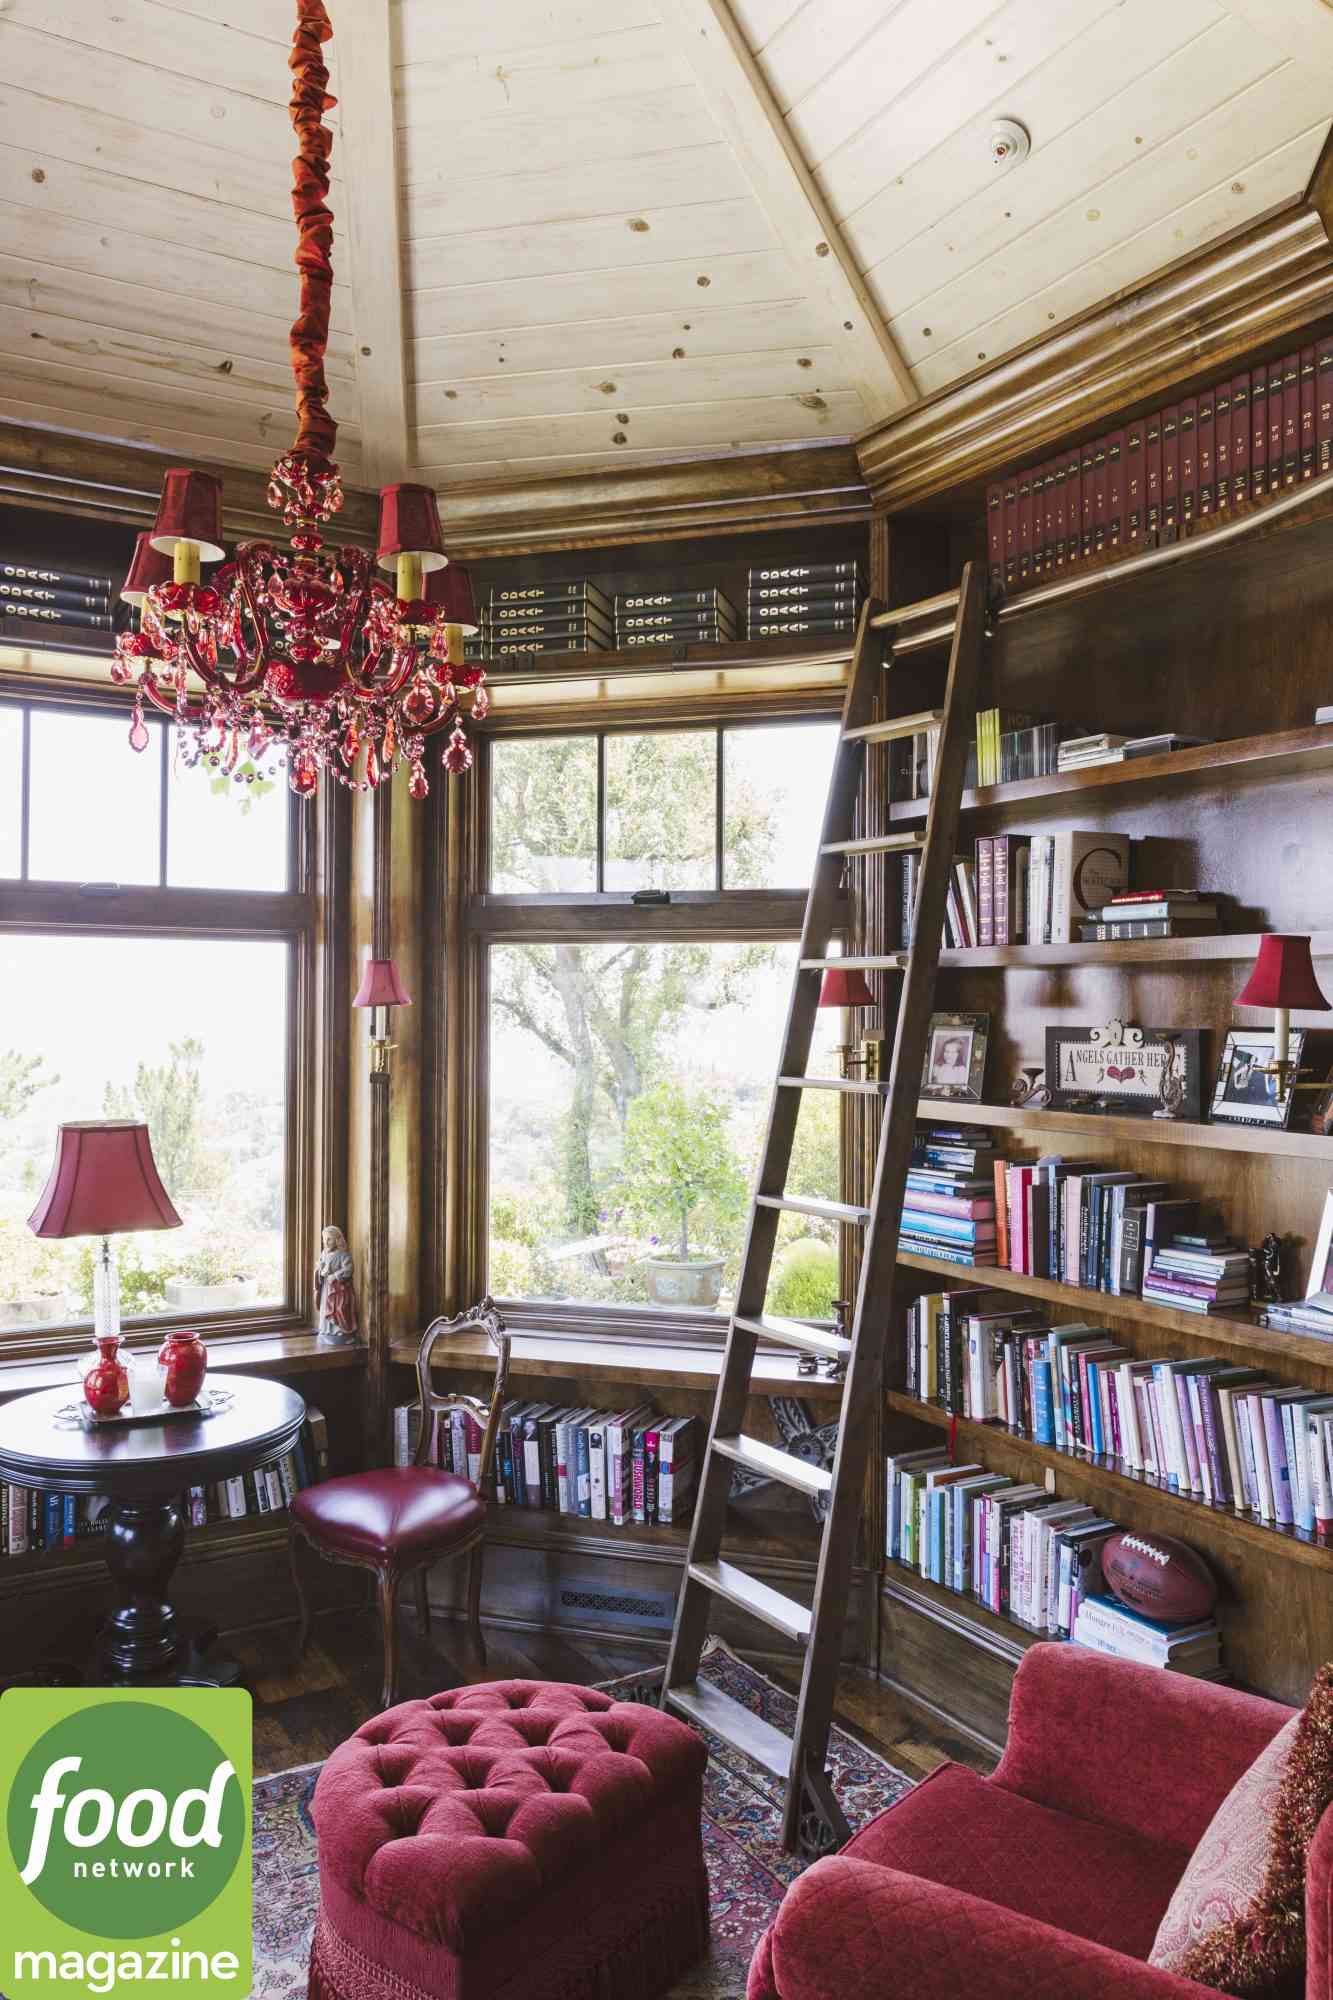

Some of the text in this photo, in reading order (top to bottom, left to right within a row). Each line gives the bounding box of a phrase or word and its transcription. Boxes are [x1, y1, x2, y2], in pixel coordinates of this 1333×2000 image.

[4, 567, 61, 582] ODAAT
[760, 568, 809, 580] ODAAT
[0, 585, 55, 600] ODAAT
[501, 589, 545, 600] ODAAT
[760, 586, 808, 598] ODAAT
[625, 596, 672, 608] ODAAT
[6, 604, 62, 619] ODAAT
[500, 607, 544, 618] ODAAT
[760, 605, 808, 616] ODAAT
[625, 616, 672, 627] ODAAT
[501, 625, 545, 636] ODAAT
[760, 623, 808, 635] ODAAT
[627, 633, 673, 645] ODAAT
[501, 643, 544, 654] ODAAT
[1107, 1051, 1144, 1067] GATHER
